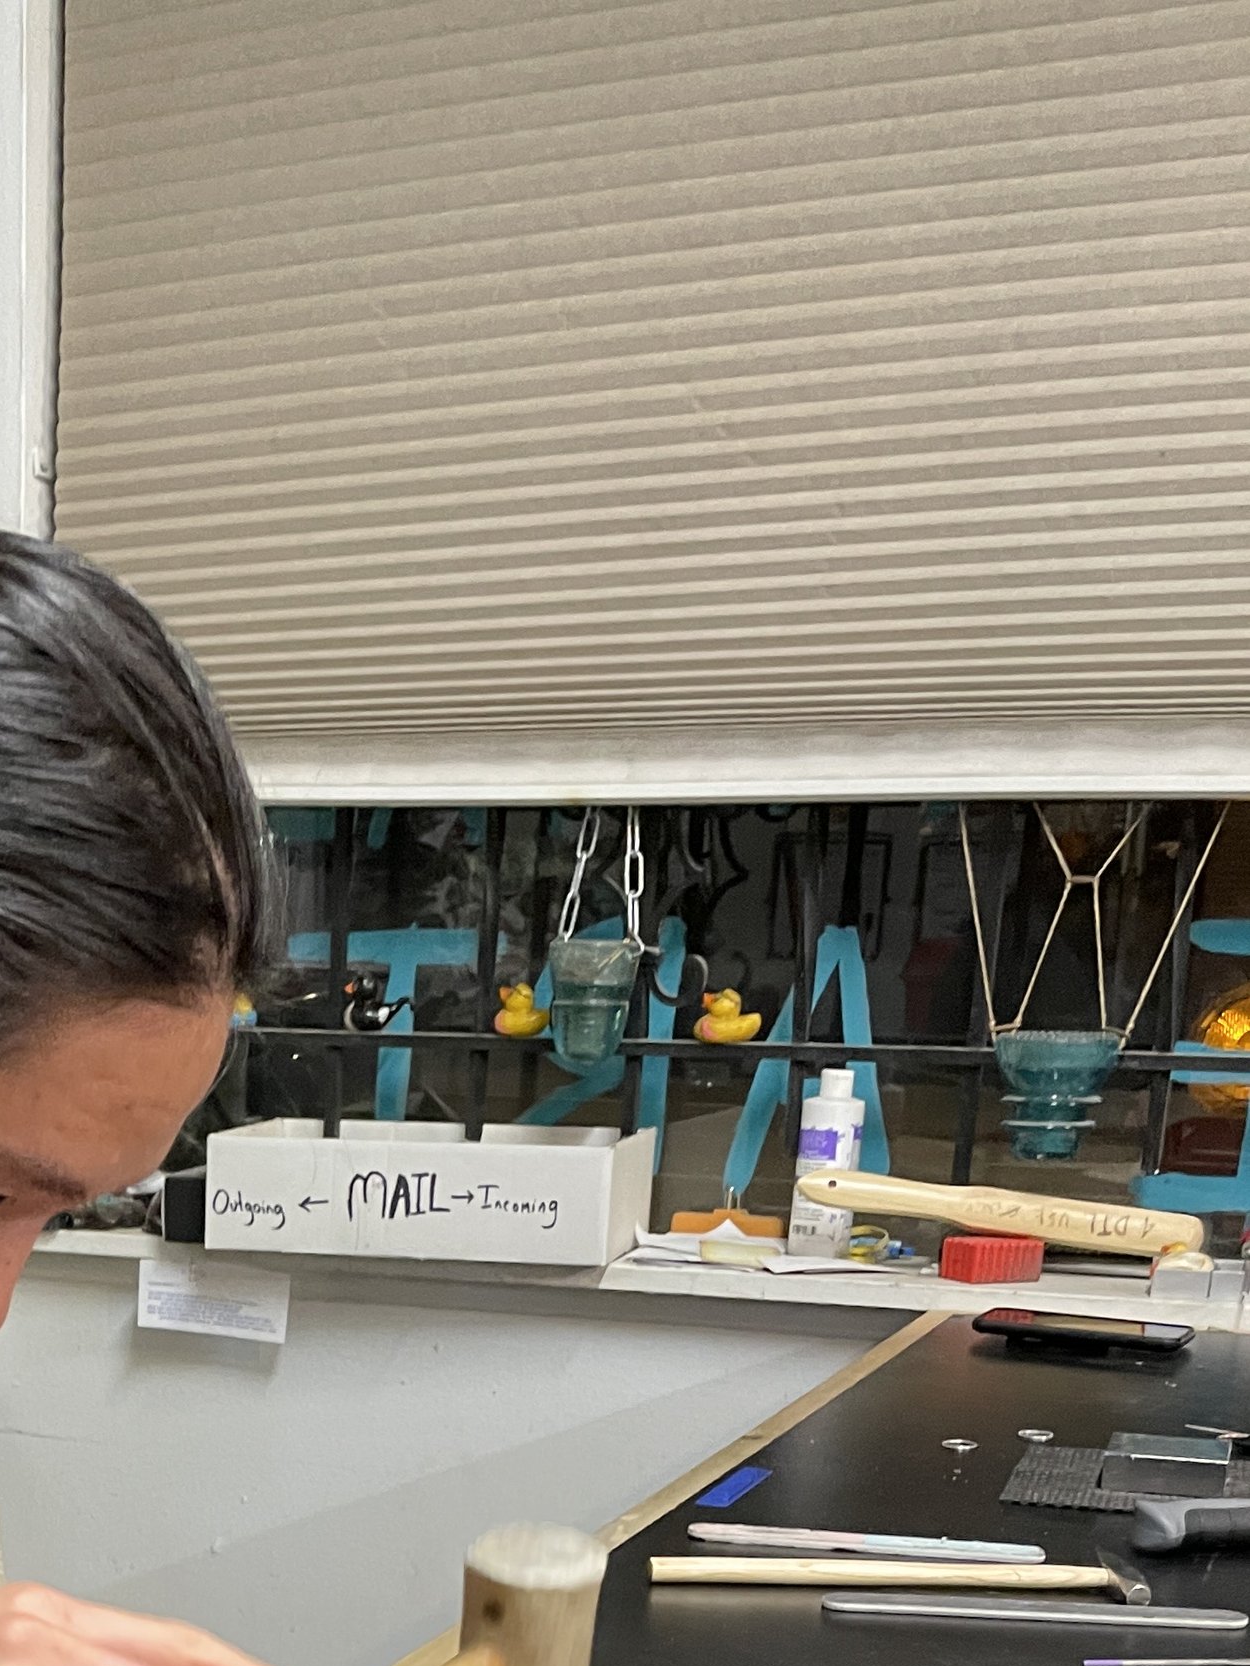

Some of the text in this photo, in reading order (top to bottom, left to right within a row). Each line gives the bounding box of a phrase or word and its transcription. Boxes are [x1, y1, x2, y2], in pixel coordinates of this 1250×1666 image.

[212, 1171, 558, 1230] Outgoing MAIL Incoming
